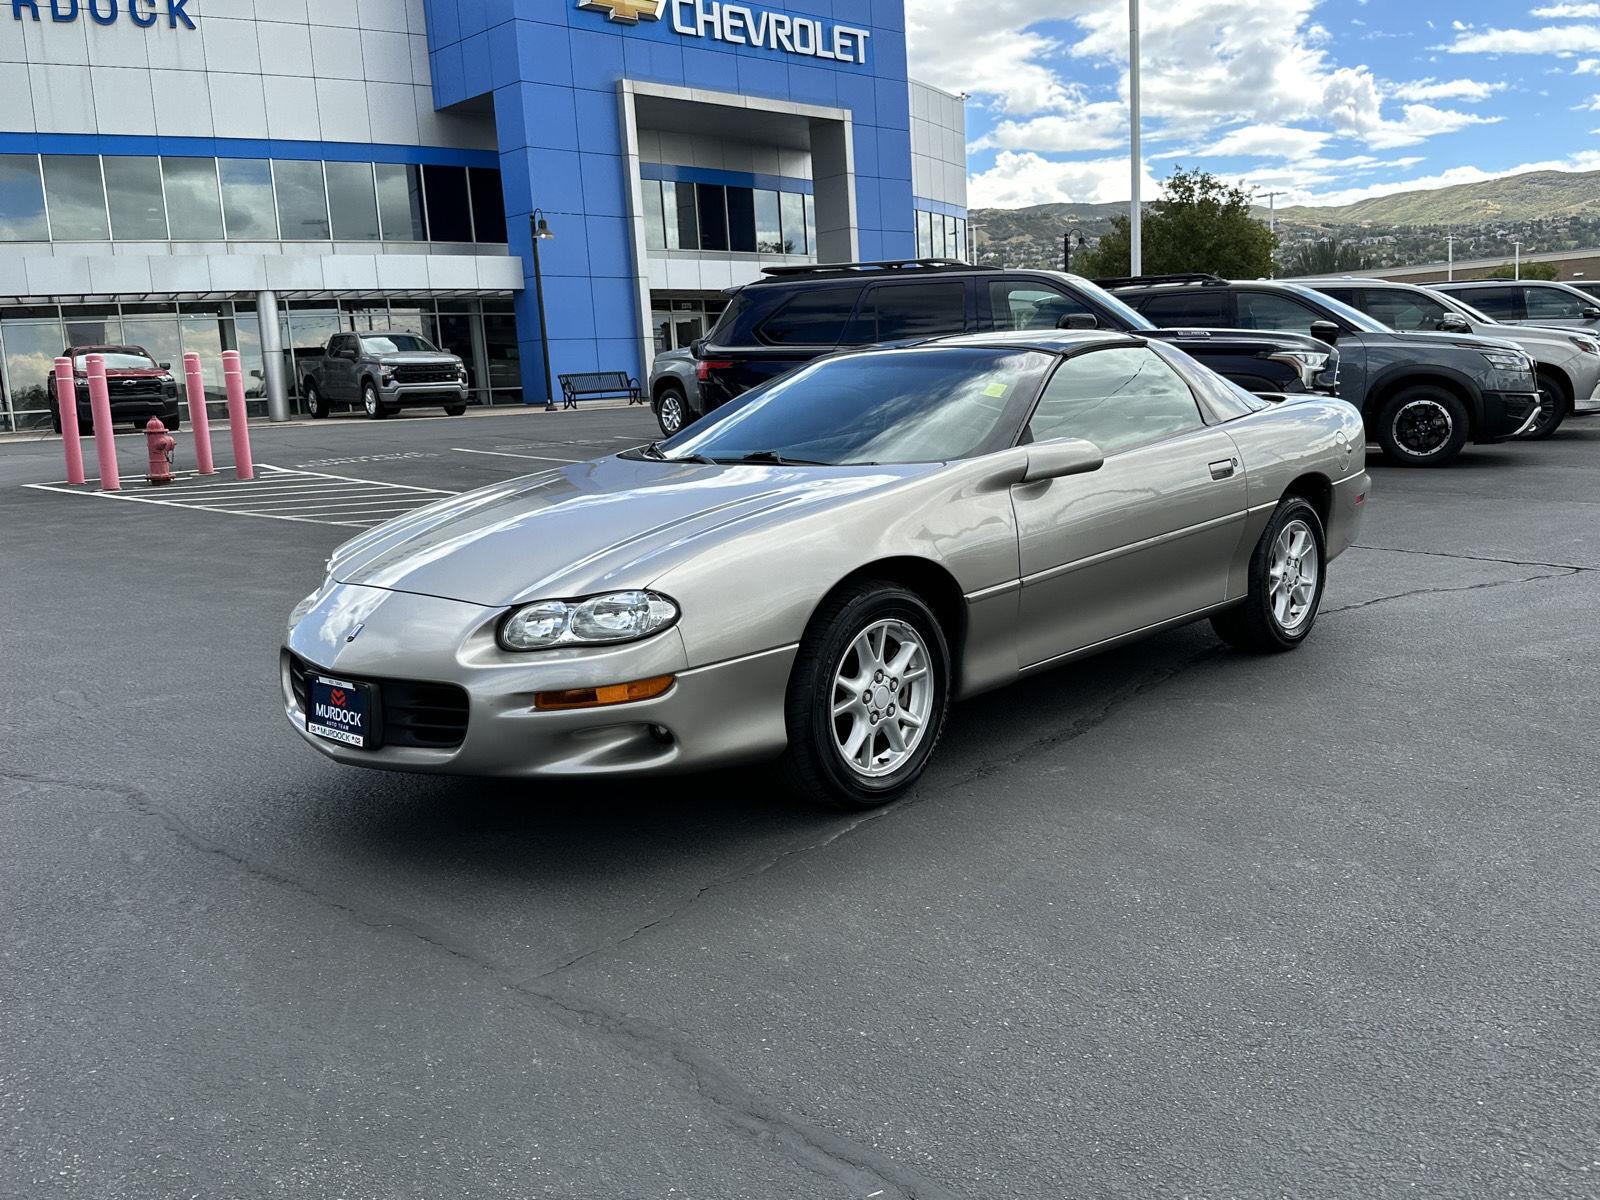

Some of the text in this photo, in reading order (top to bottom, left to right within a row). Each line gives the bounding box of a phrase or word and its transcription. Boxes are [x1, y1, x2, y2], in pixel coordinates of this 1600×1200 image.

[672, 0, 870, 64] CHEVROLET
[316, 702, 361, 727] MURDOCK
[320, 727, 351, 741] MURDOCK
